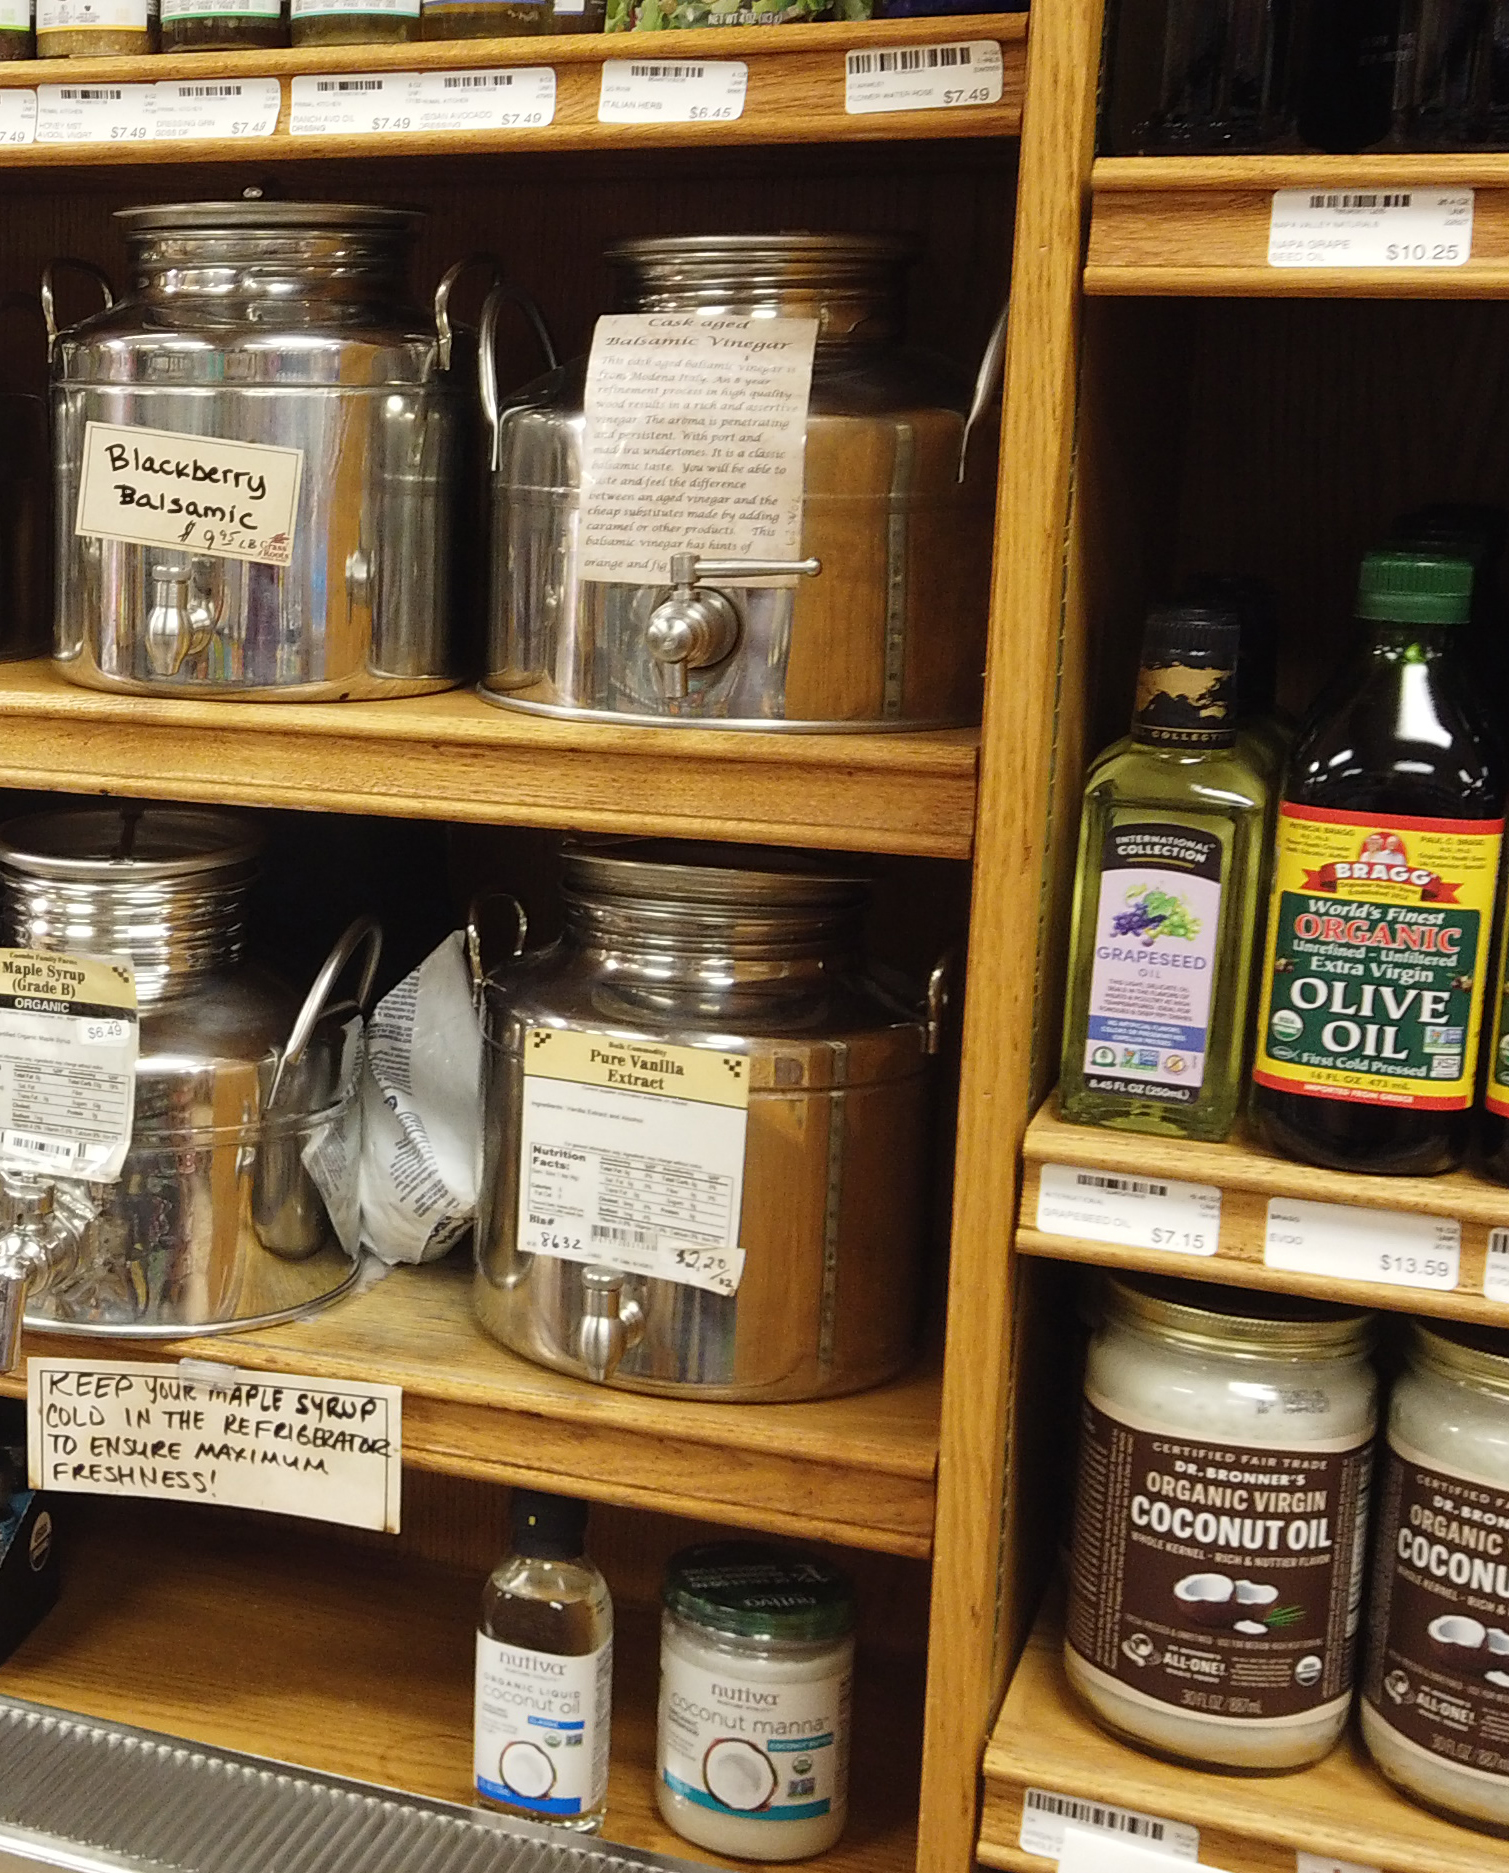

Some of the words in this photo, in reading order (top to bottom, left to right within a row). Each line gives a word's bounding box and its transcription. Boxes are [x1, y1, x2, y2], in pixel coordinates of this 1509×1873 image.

[943, 87, 990, 105] $7.49
[231, 121, 266, 135] $7.49
[372, 117, 411, 131] $7.49
[501, 112, 541, 126] $7.49
[111, 127, 146, 139] $7.49
[1386, 244, 1459, 260] $10.25
[648, 318, 693, 328] Cask
[700, 319, 749, 330] aged
[605, 336, 699, 347] Balsamic
[709, 335, 792, 352] Vinegar
[104, 443, 266, 499] Blackberry
[114, 484, 258, 529] Balsamic
[1115, 835, 1210, 853] INTERNATIONAL
[1117, 845, 1206, 863] COLLECTION
[1334, 863, 1430, 885] BRAGG
[1308, 899, 1382, 920] World's
[1386, 908, 1445, 925] Finest
[1293, 913, 1462, 953] ORGANIC
[1097, 946, 1207, 970] GRAPESEED
[1292, 939, 1366, 959] Unrefined
[1380, 947, 1458, 967] Unfiltered
[3, 962, 43, 977] Maple
[47, 966, 85, 983] Syrup
[1138, 968, 1161, 978] OIL
[1310, 956, 1364, 976] Extra
[1369, 963, 1433, 985] Virgin
[13, 978, 57, 994] (Grade
[61, 983, 76, 999] B)
[1290, 977, 1451, 1024] OLIVE
[15, 998, 69, 1013] ORGANIC
[87, 1023, 122, 1039] $6.49
[1322, 1020, 1409, 1060] OIL
[590, 1049, 626, 1066] Pure
[630, 1055, 684, 1076] Vanilla
[1301, 1052, 1333, 1067] First
[1338, 1059, 1369, 1072] Cold
[1371, 1061, 1427, 1078] Pressed
[608, 1069, 664, 1090] Extract
[532, 1157, 570, 1170] Facts:
[533, 1146, 586, 1162] Nutrition
[540, 1232, 583, 1249] 8632
[1151, 1227, 1205, 1249] $7.15
[1381, 1254, 1449, 1278] $13.59
[48, 1372, 133, 1397] KEEP
[145, 1377, 197, 1404] YOUR
[295, 1394, 377, 1424] SYRUP
[46, 1403, 105, 1428] COLD
[125, 1408, 151, 1429] IN
[162, 1410, 205, 1430] THE
[223, 1413, 392, 1458] REFRIGERATOR
[48, 1433, 77, 1454] TO
[90, 1436, 180, 1459] ENSURE
[195, 1442, 328, 1475] MAXIMUM
[1152, 1441, 1235, 1464] CERTIFIED
[1240, 1454, 1277, 1467] FAIR
[1282, 1458, 1328, 1470] TRADE
[52, 1463, 216, 1497] FRESHNESS!
[1146, 1471, 1248, 1512] ORGANIC
[1253, 1490, 1328, 1514] VIRGIN
[1130, 1494, 1284, 1551] COCONUT
[1287, 1517, 1332, 1551] OIL
[1410, 1504, 1504, 1555] ORGANIC
[499, 1651, 565, 1676] nutiva
[483, 1684, 554, 1714] coconut
[559, 1700, 580, 1714] oil
[711, 1682, 778, 1707] nutiva
[671, 1692, 745, 1731] coconut
[752, 1717, 826, 1736] manna
